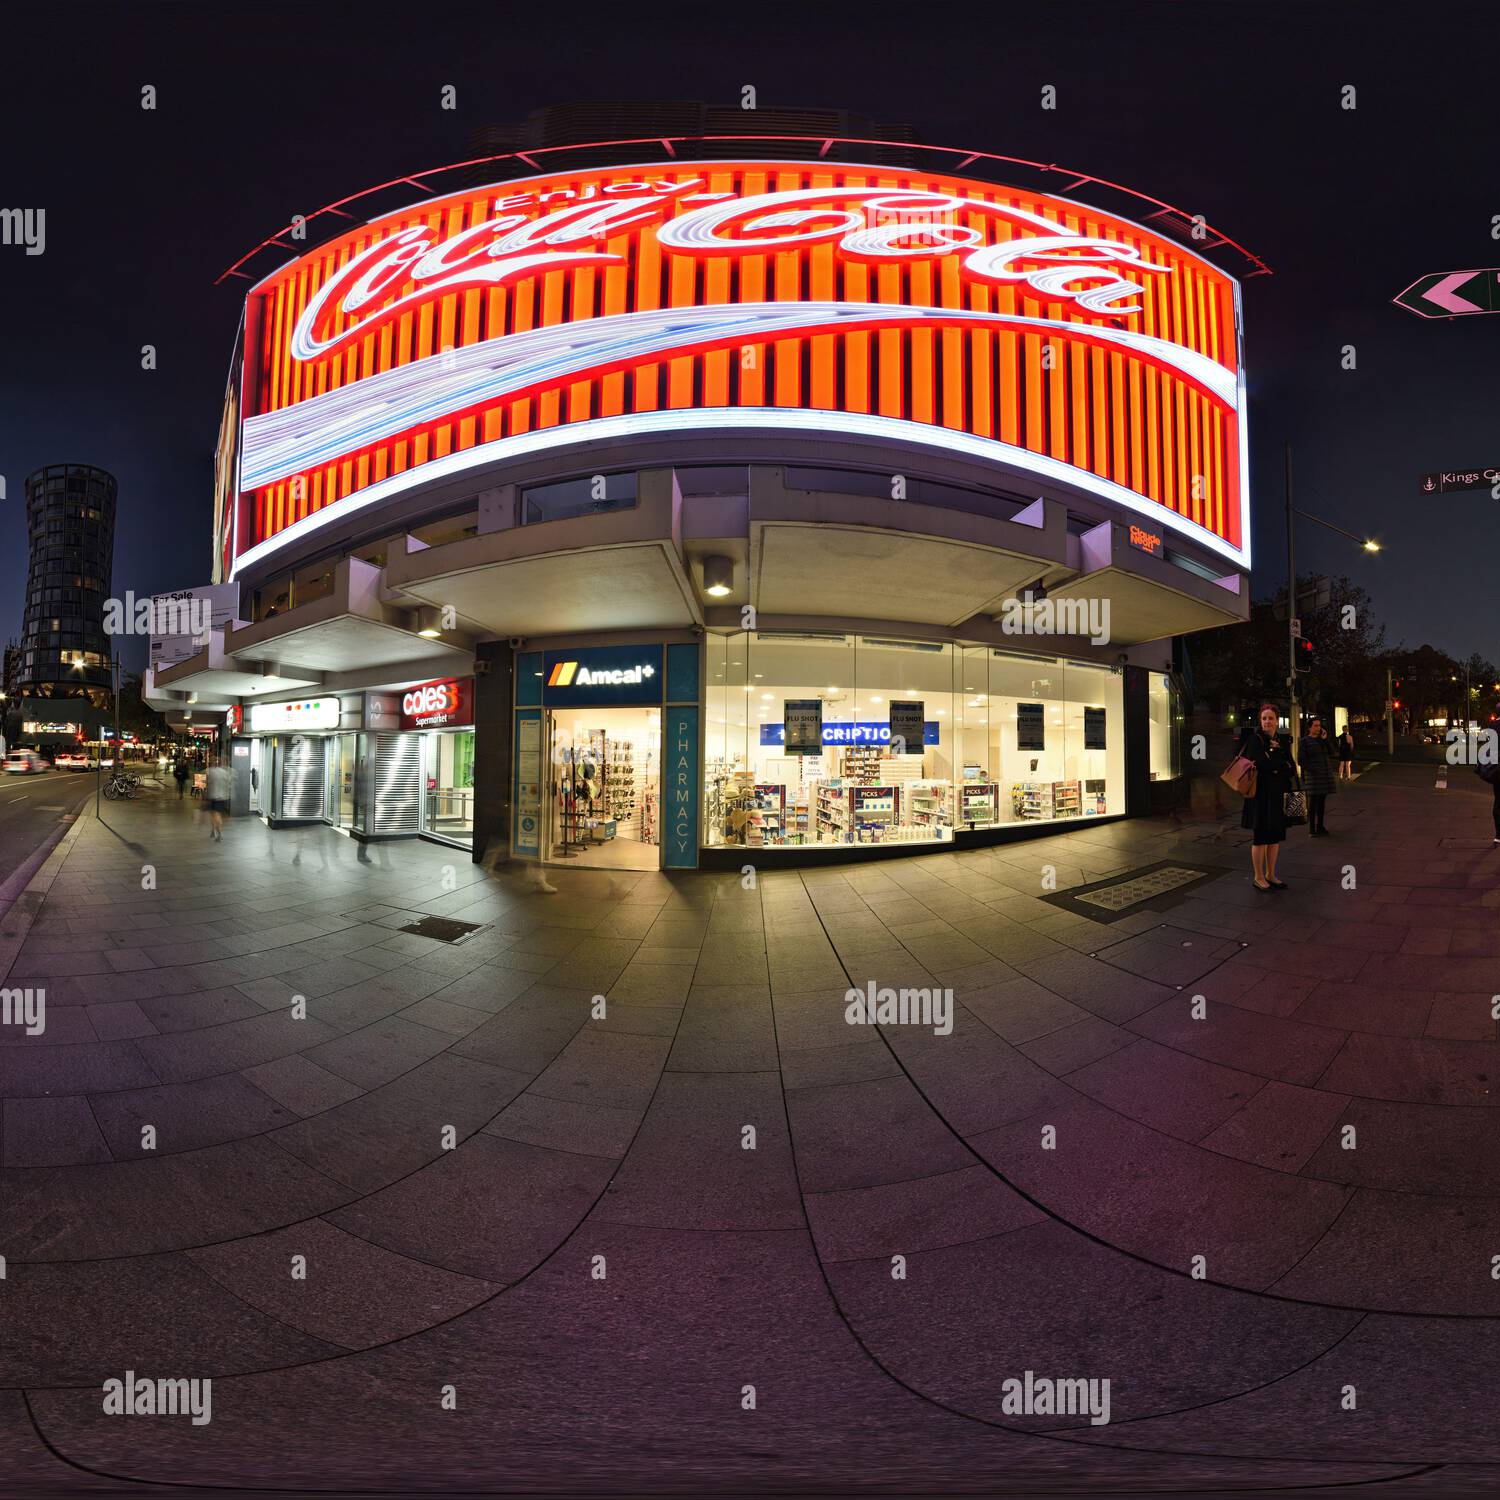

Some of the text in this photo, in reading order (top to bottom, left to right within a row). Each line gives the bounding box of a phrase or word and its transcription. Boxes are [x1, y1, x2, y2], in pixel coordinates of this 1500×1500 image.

[494, 178, 704, 212] Enjoy
[1442, 472, 1479, 484] Kings
[1130, 525, 1161, 546] Claude
[171, 591, 193, 602] Sale
[403, 684, 447, 716] coles
[415, 713, 448, 727] Supermarket
[822, 727, 891, 740] CRIPTIO
[676, 722, 689, 853] PHARMACY
